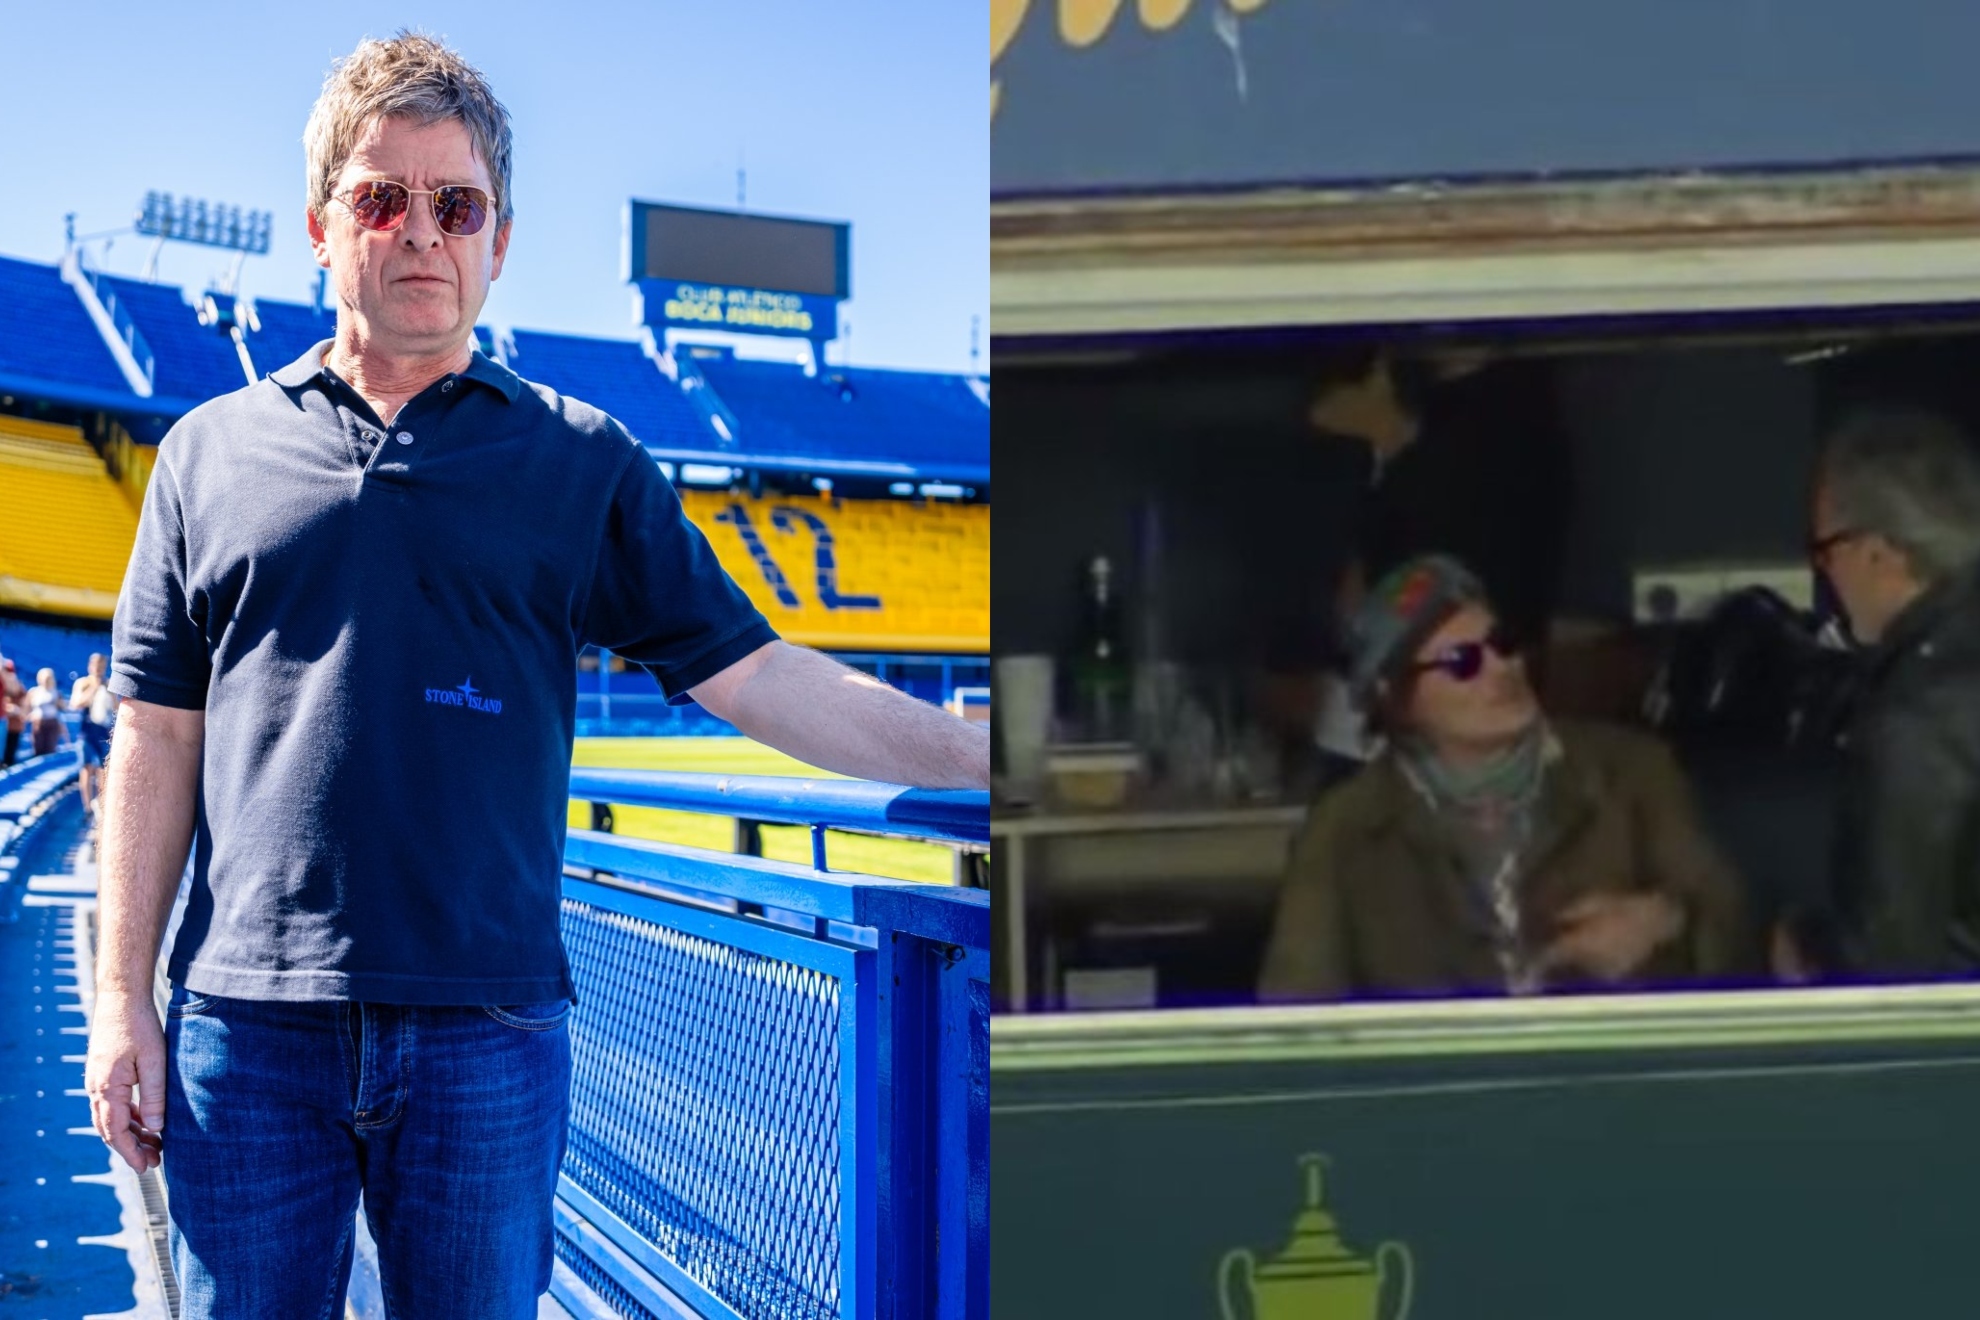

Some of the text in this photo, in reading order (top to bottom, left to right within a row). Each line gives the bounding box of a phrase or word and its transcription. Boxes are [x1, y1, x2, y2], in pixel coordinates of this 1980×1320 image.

[665, 300, 812, 331] BOCA JUNIORS
[715, 504, 881, 613] 12
[425, 688, 502, 714] STONE ISLAND
